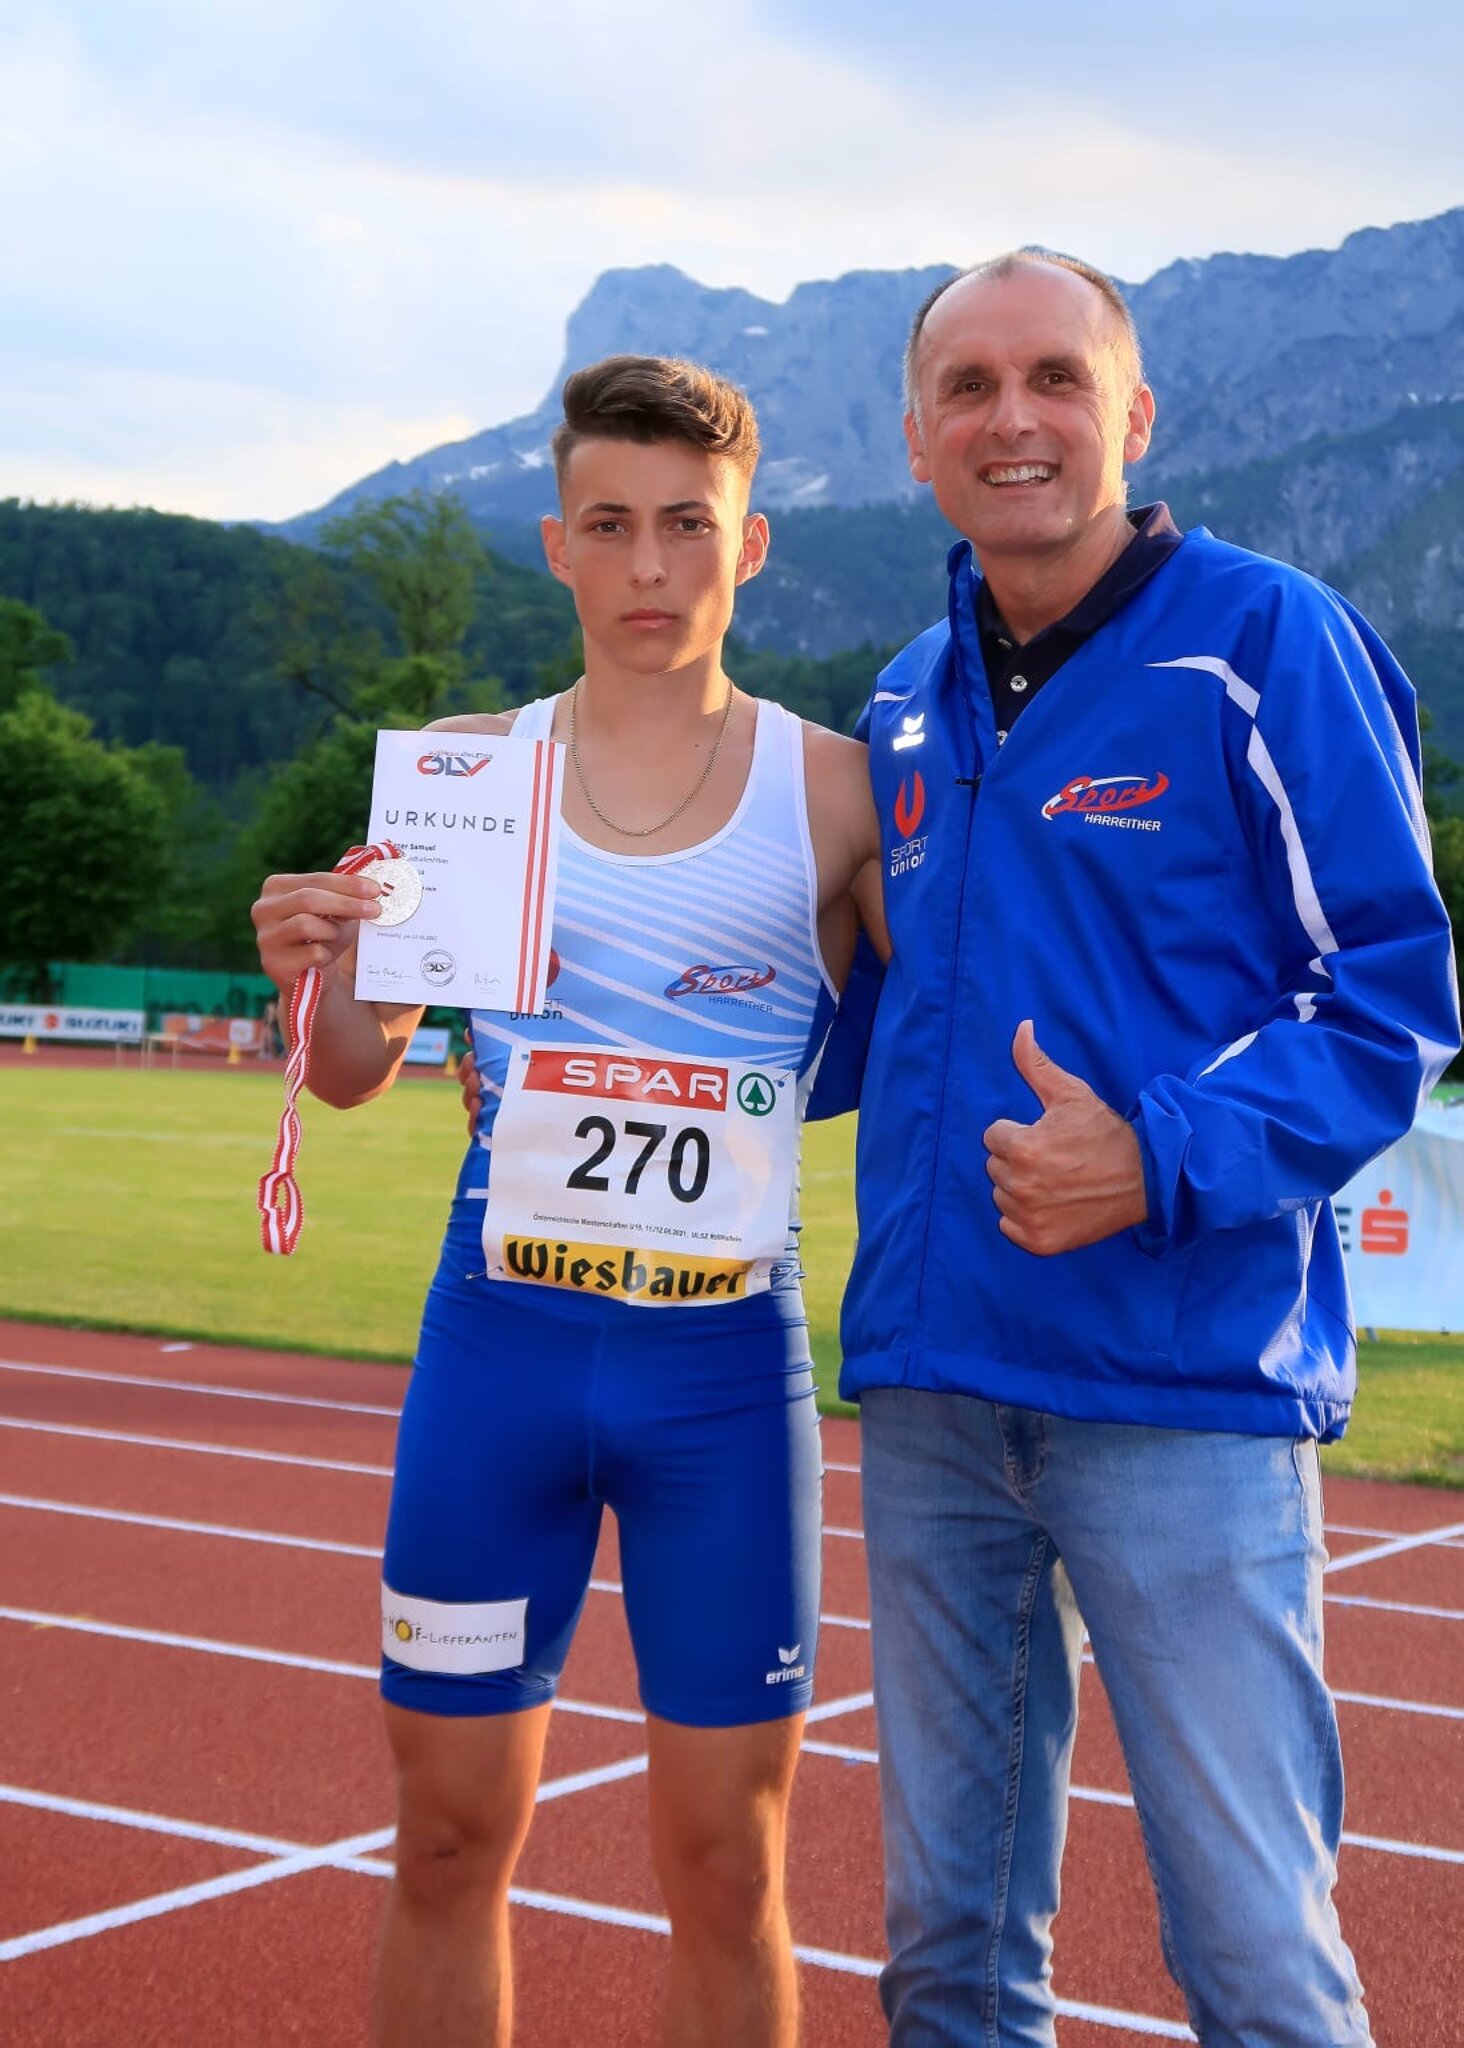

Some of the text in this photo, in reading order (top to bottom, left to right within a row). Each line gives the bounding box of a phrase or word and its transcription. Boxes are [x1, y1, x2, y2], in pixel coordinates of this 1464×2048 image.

[1045, 772, 1169, 815] Sport
[385, 810, 516, 834] URKUNDE
[1084, 813, 1162, 832] HARREITHER
[891, 835, 929, 864] SPORT
[668, 964, 776, 996] Sport
[708, 995, 774, 1015] HARREITHER
[65, 1015, 138, 1033] SUZUKI
[562, 1059, 724, 1102] SPAR
[566, 1116, 710, 1203] 270
[507, 1240, 749, 1298] Wiesbauer
[766, 1665, 805, 1684] erima
